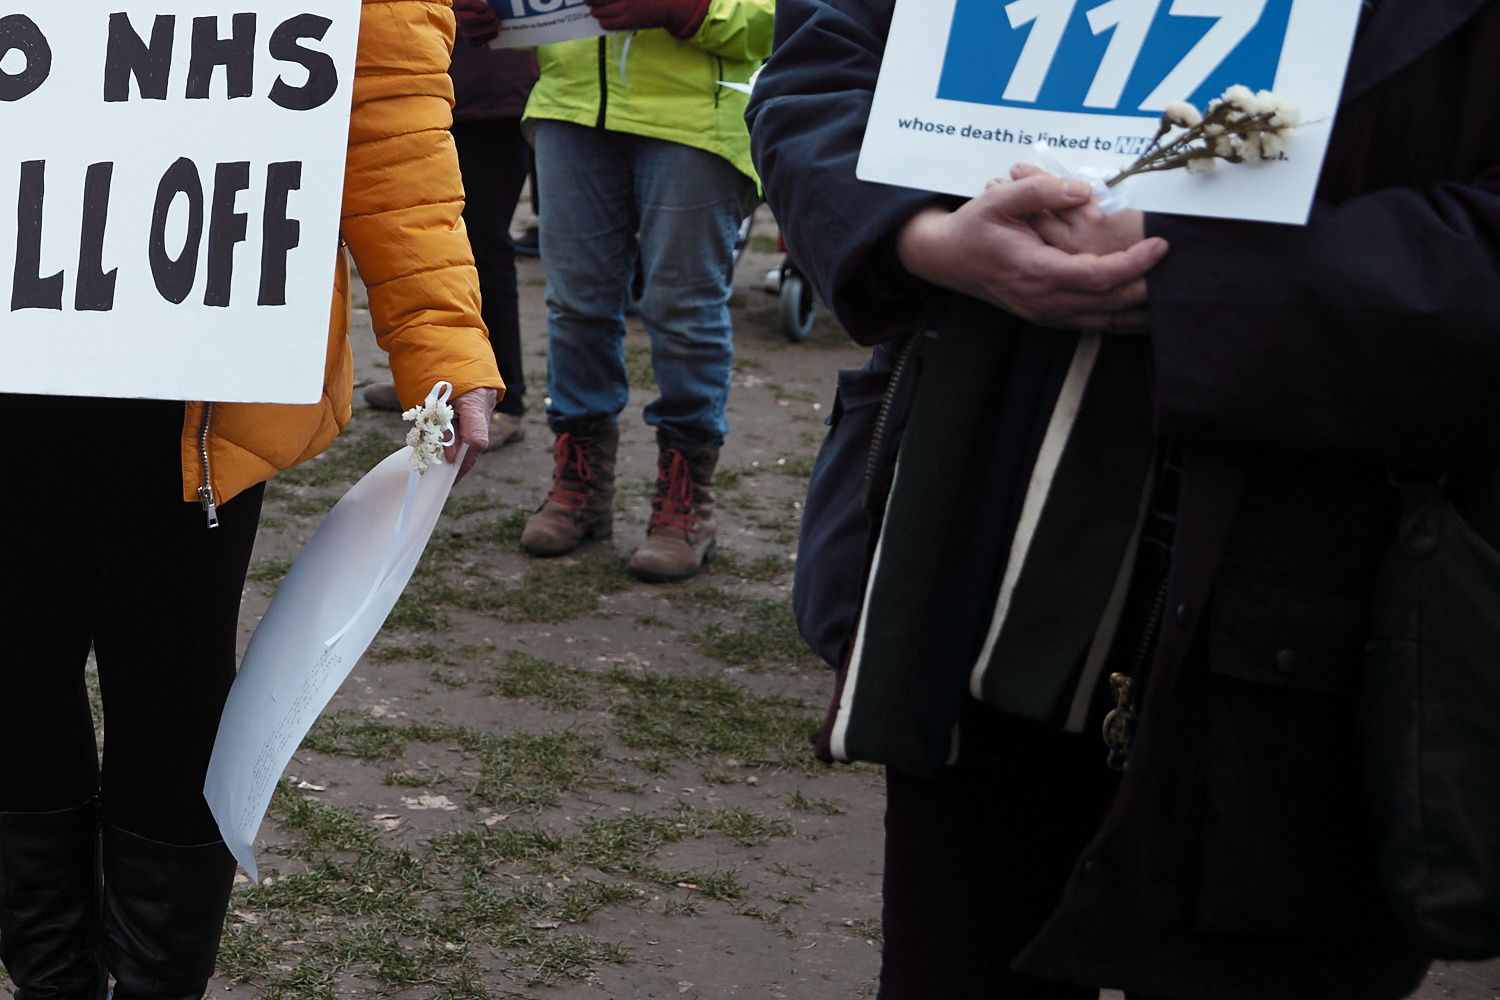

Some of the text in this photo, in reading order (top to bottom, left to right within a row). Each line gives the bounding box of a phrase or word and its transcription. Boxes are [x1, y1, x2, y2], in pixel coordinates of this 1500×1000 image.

[103, 11, 339, 111] NHS
[898, 117, 956, 136] whose
[960, 124, 1014, 144] death
[1018, 130, 1033, 146] is
[1037, 132, 1090, 151] linked
[1094, 136, 1112, 151] to
[148, 156, 303, 308] OFF
